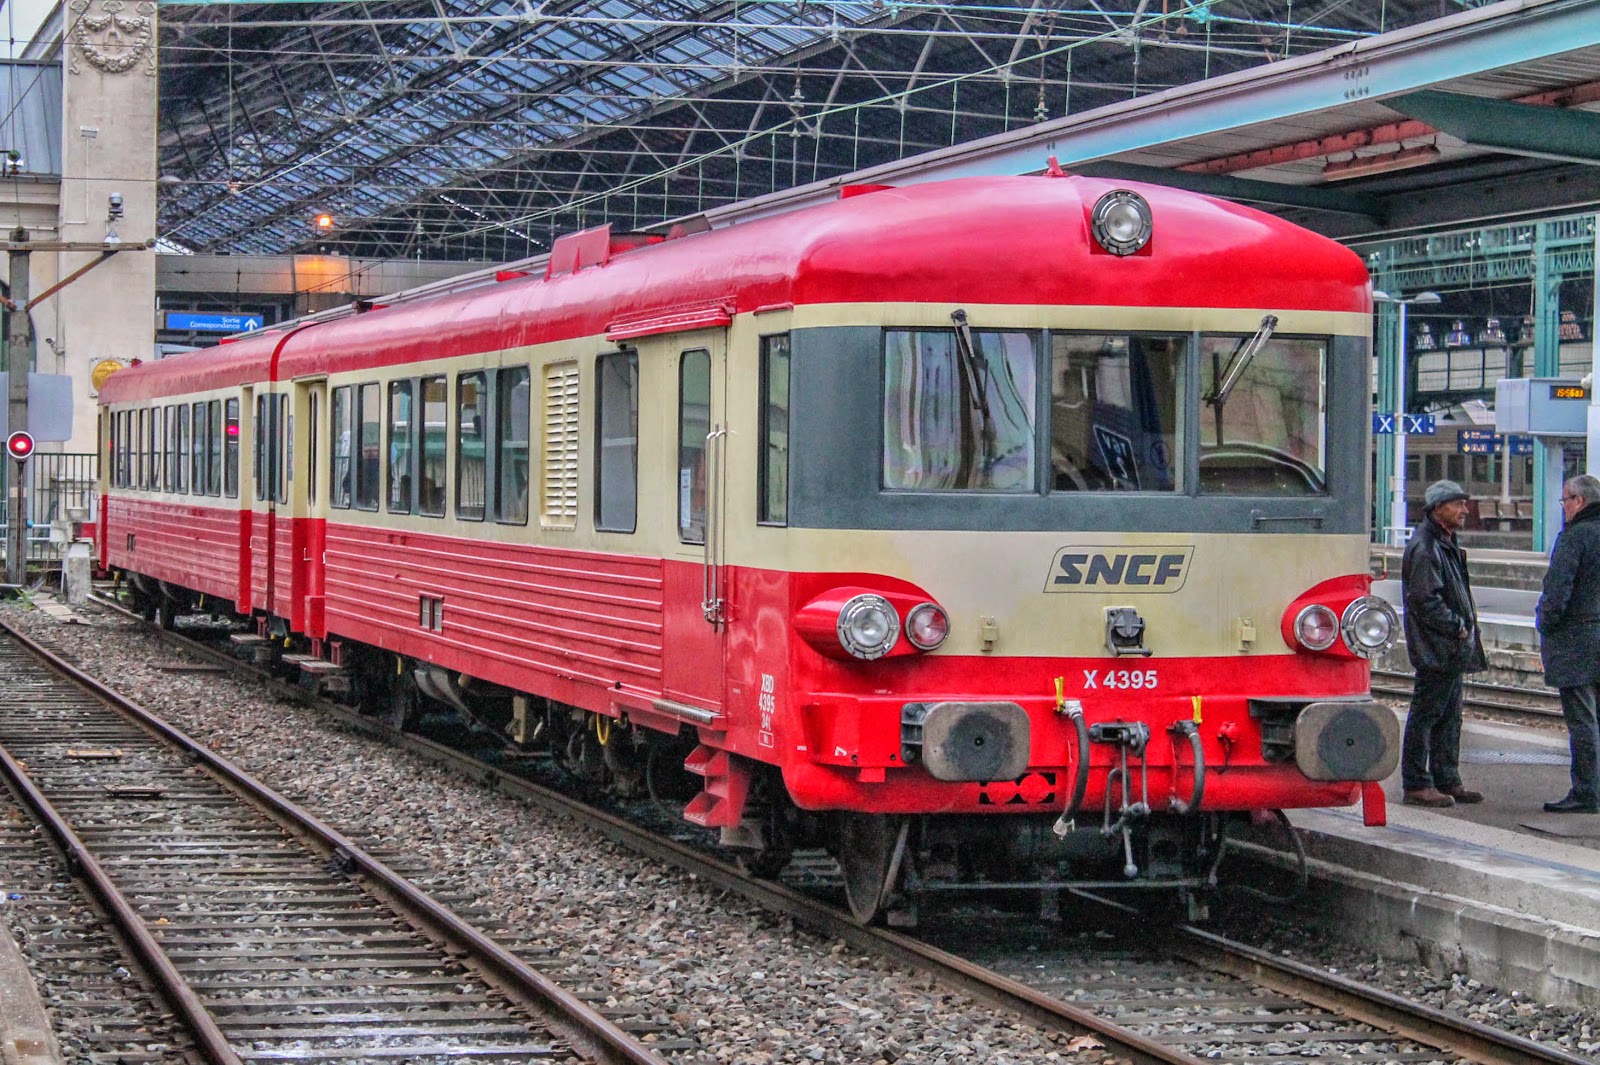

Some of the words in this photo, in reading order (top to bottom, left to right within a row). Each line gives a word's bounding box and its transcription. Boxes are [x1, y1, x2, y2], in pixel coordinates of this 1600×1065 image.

[189, 321, 240, 329] Correspondance
[1379, 417, 1392, 433] X
[1410, 418, 1423, 433] X
[1054, 554, 1185, 585] SNCF
[761, 673, 774, 693] XBD
[1083, 669, 1098, 689] X
[1103, 669, 1158, 689] 4395
[758, 692, 775, 714] 4395
